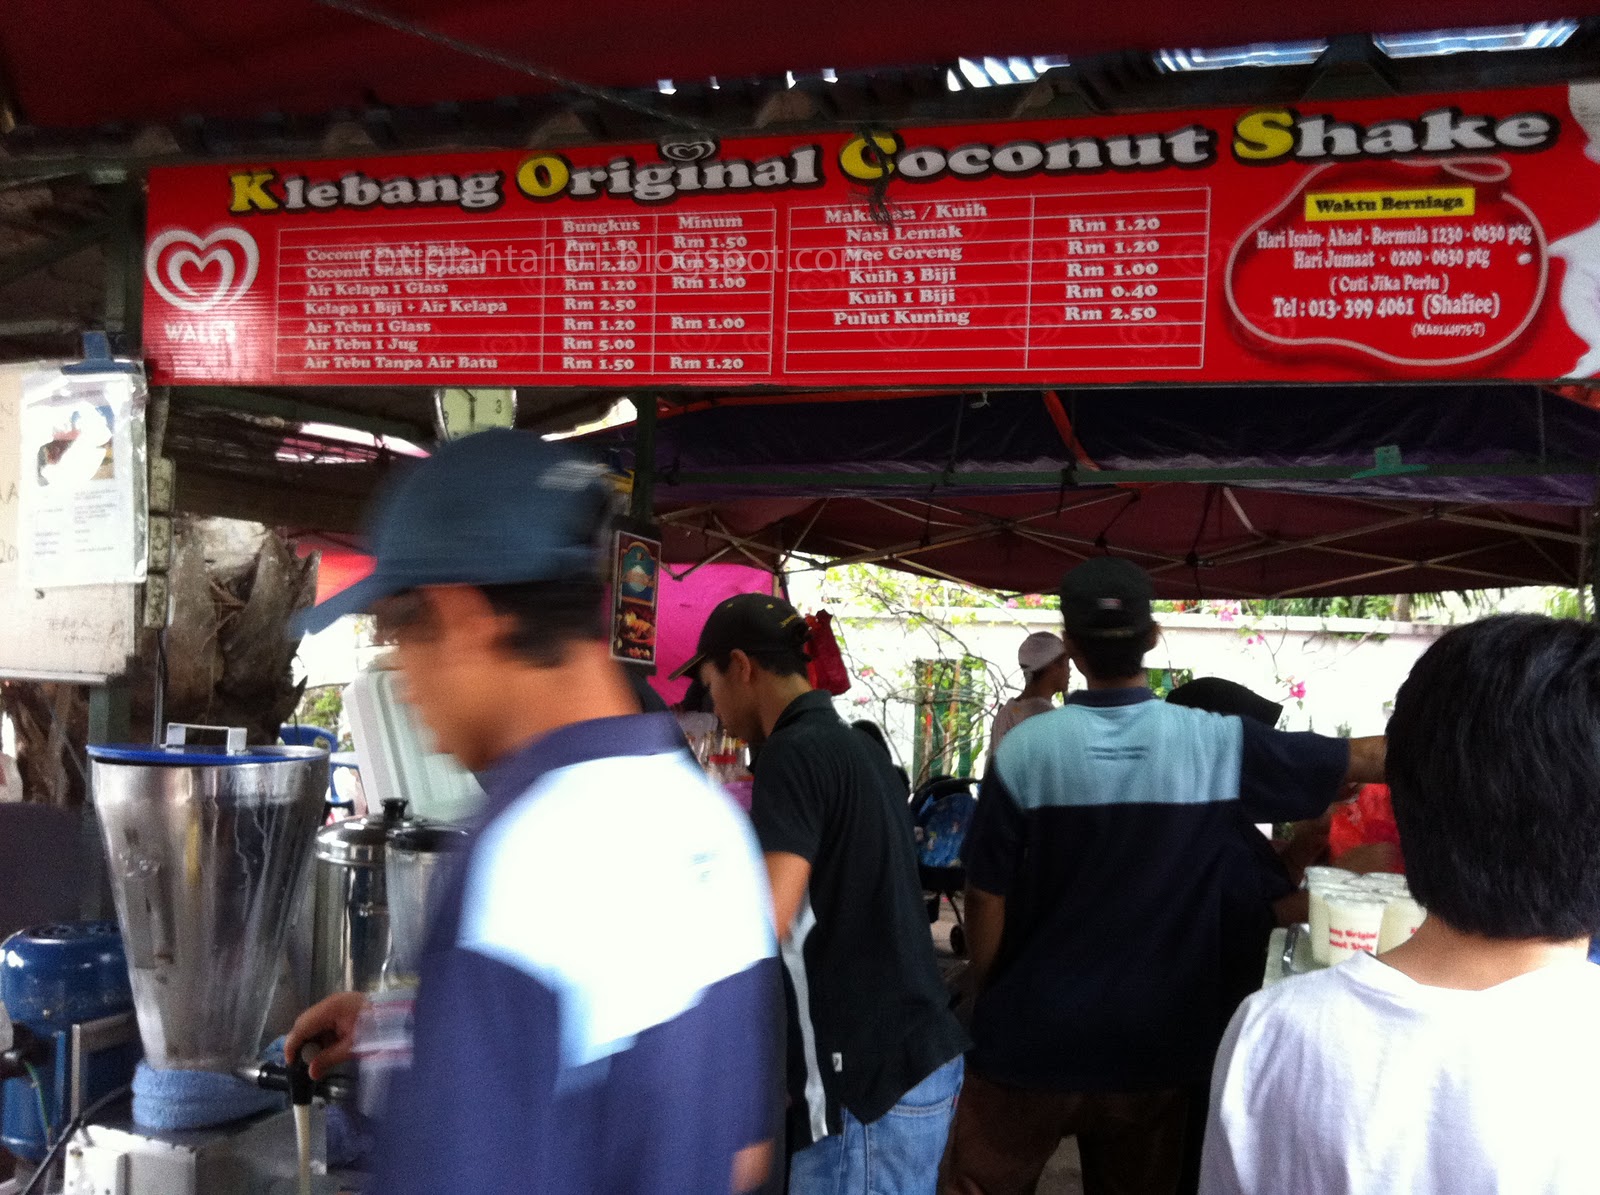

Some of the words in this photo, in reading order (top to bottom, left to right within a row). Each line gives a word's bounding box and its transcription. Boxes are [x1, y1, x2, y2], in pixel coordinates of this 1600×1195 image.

[228, 171, 503, 213] Klebang
[516, 147, 821, 201] Original
[838, 126, 1211, 180] Coconut
[1232, 109, 1551, 160] Shake
[936, 203, 988, 218] Kuih
[1315, 198, 1377, 213] Waktu
[1381, 195, 1465, 213] Berniaga
[562, 219, 641, 235] Bungkus
[678, 215, 743, 230] Minum
[1068, 218, 1107, 233] Rm
[1114, 216, 1162, 232] 1.20
[846, 227, 889, 242] Nasi
[894, 224, 964, 241] Lemak
[1257, 230, 1286, 249] Hari
[1328, 226, 1362, 247] Ahad
[1371, 226, 1429, 246] Bermula
[1431, 225, 1463, 245] 1230
[1472, 224, 1506, 245] 0630
[1507, 223, 1533, 246] ptg
[565, 239, 596, 252] Rm
[673, 235, 705, 249] Rm
[709, 235, 748, 250] 1.50
[1067, 240, 1106, 255] Rm
[1114, 239, 1161, 254] 1.20
[306, 248, 372, 262] Coconut
[673, 255, 704, 269] Rm
[846, 247, 884, 263] Mee
[888, 246, 964, 262] Goreng
[1294, 249, 1323, 269] Hari
[1325, 248, 1376, 269] Jumaat
[1390, 249, 1423, 267] 0200
[1431, 247, 1465, 268] 0630
[1466, 247, 1491, 269] ptg
[306, 265, 371, 279] Coconut
[426, 261, 487, 278] Special
[565, 259, 596, 272] Rm
[1067, 262, 1106, 278] Rm
[1113, 261, 1160, 277] 1.00
[672, 276, 704, 289] Rm
[709, 276, 747, 289] 1.00
[849, 269, 899, 285] Kuih
[903, 270, 916, 285] 3
[920, 266, 958, 283] Biji
[1370, 273, 1401, 292] Jika
[306, 283, 332, 298] Air
[335, 282, 390, 298] Kelapa
[393, 284, 403, 295] 1
[405, 281, 449, 295] Glass
[564, 278, 596, 292] Rm
[601, 278, 637, 292] 1.20
[1065, 284, 1105, 300] Rm
[1110, 283, 1159, 299] 0.40
[848, 289, 898, 306] Kuih
[903, 291, 913, 305] 1
[918, 287, 956, 305] Biji
[305, 301, 359, 316] Kelapa
[362, 303, 371, 315] 1
[374, 299, 403, 316] Biji
[419, 299, 447, 314] Air
[451, 298, 509, 315] Kelapa
[564, 298, 595, 312] Rm
[600, 298, 637, 312] 2.50
[1343, 297, 1374, 320] 399
[1376, 296, 1415, 319] 4061
[833, 309, 890, 327] Pulut
[893, 307, 971, 326] Kuning
[1064, 306, 1103, 322] Rm
[1110, 306, 1158, 321] 2.50
[305, 320, 332, 335] Air
[334, 320, 373, 334] Tebu
[376, 322, 385, 333] 1
[388, 319, 432, 334] Glass
[563, 318, 595, 332] Rm
[600, 318, 636, 331] 1.20
[671, 315, 703, 330] Rm
[708, 316, 746, 330] 1.00
[305, 338, 332, 351] Air
[334, 338, 372, 351] Tebu
[376, 339, 385, 351] 1
[387, 337, 419, 353] Jug
[563, 337, 594, 351] Rm
[599, 337, 636, 351] 5.00
[304, 356, 330, 370] Air
[333, 356, 372, 370] Tebu
[375, 356, 424, 372] Tanpa
[427, 356, 455, 369] Air
[457, 355, 499, 370] Batu
[562, 356, 594, 370] Rm
[599, 357, 636, 371] 1.50
[670, 356, 702, 370] Rm
[706, 357, 744, 371] 1.20
